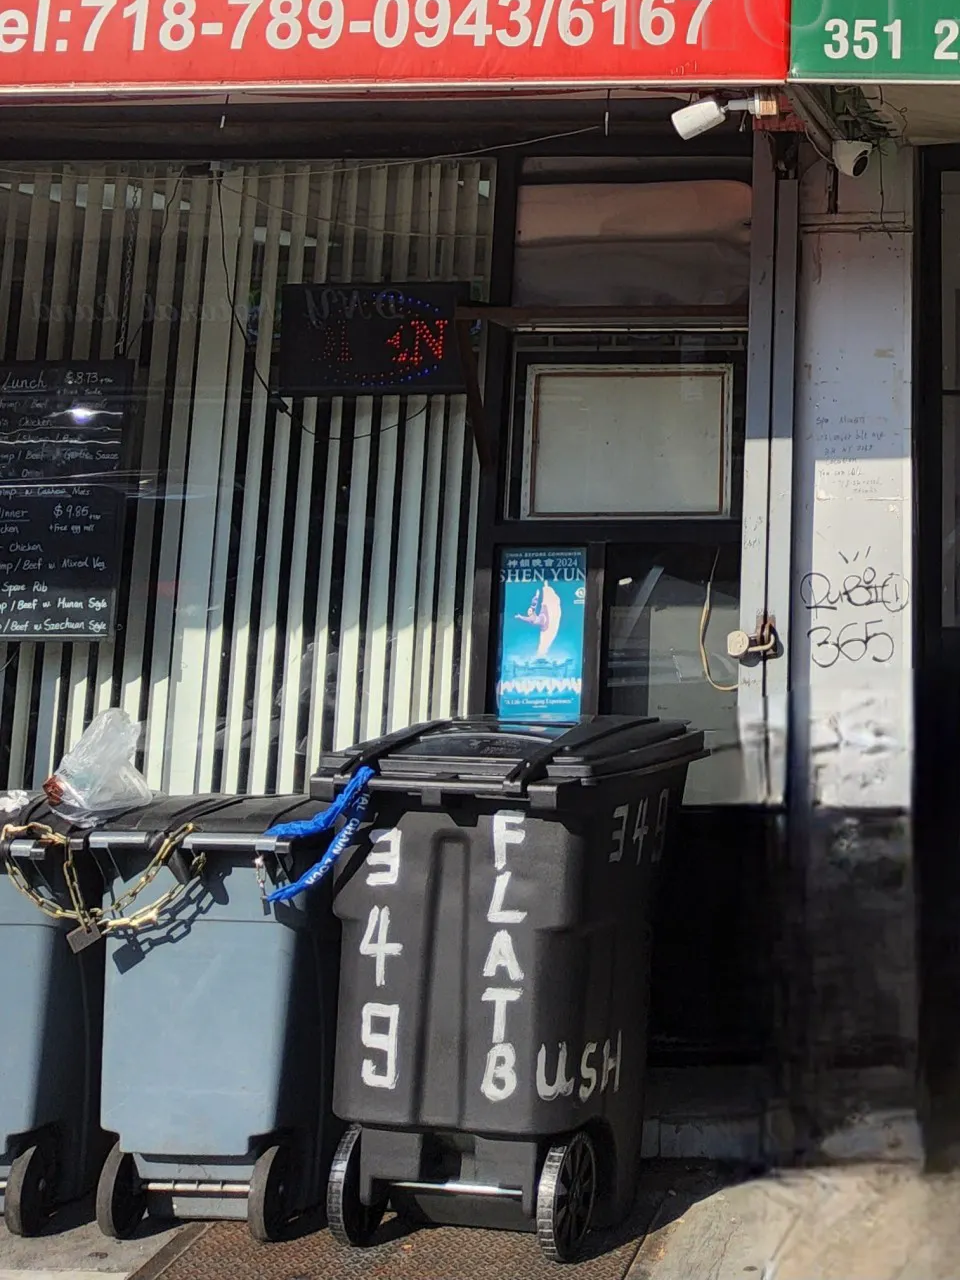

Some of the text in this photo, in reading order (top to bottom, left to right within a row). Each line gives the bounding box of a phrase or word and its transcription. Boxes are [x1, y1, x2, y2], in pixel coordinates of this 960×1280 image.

[823, 18, 902, 60] 351
[499, 567, 585, 583] SHEN YUN
[807, 620, 894, 669] 365
